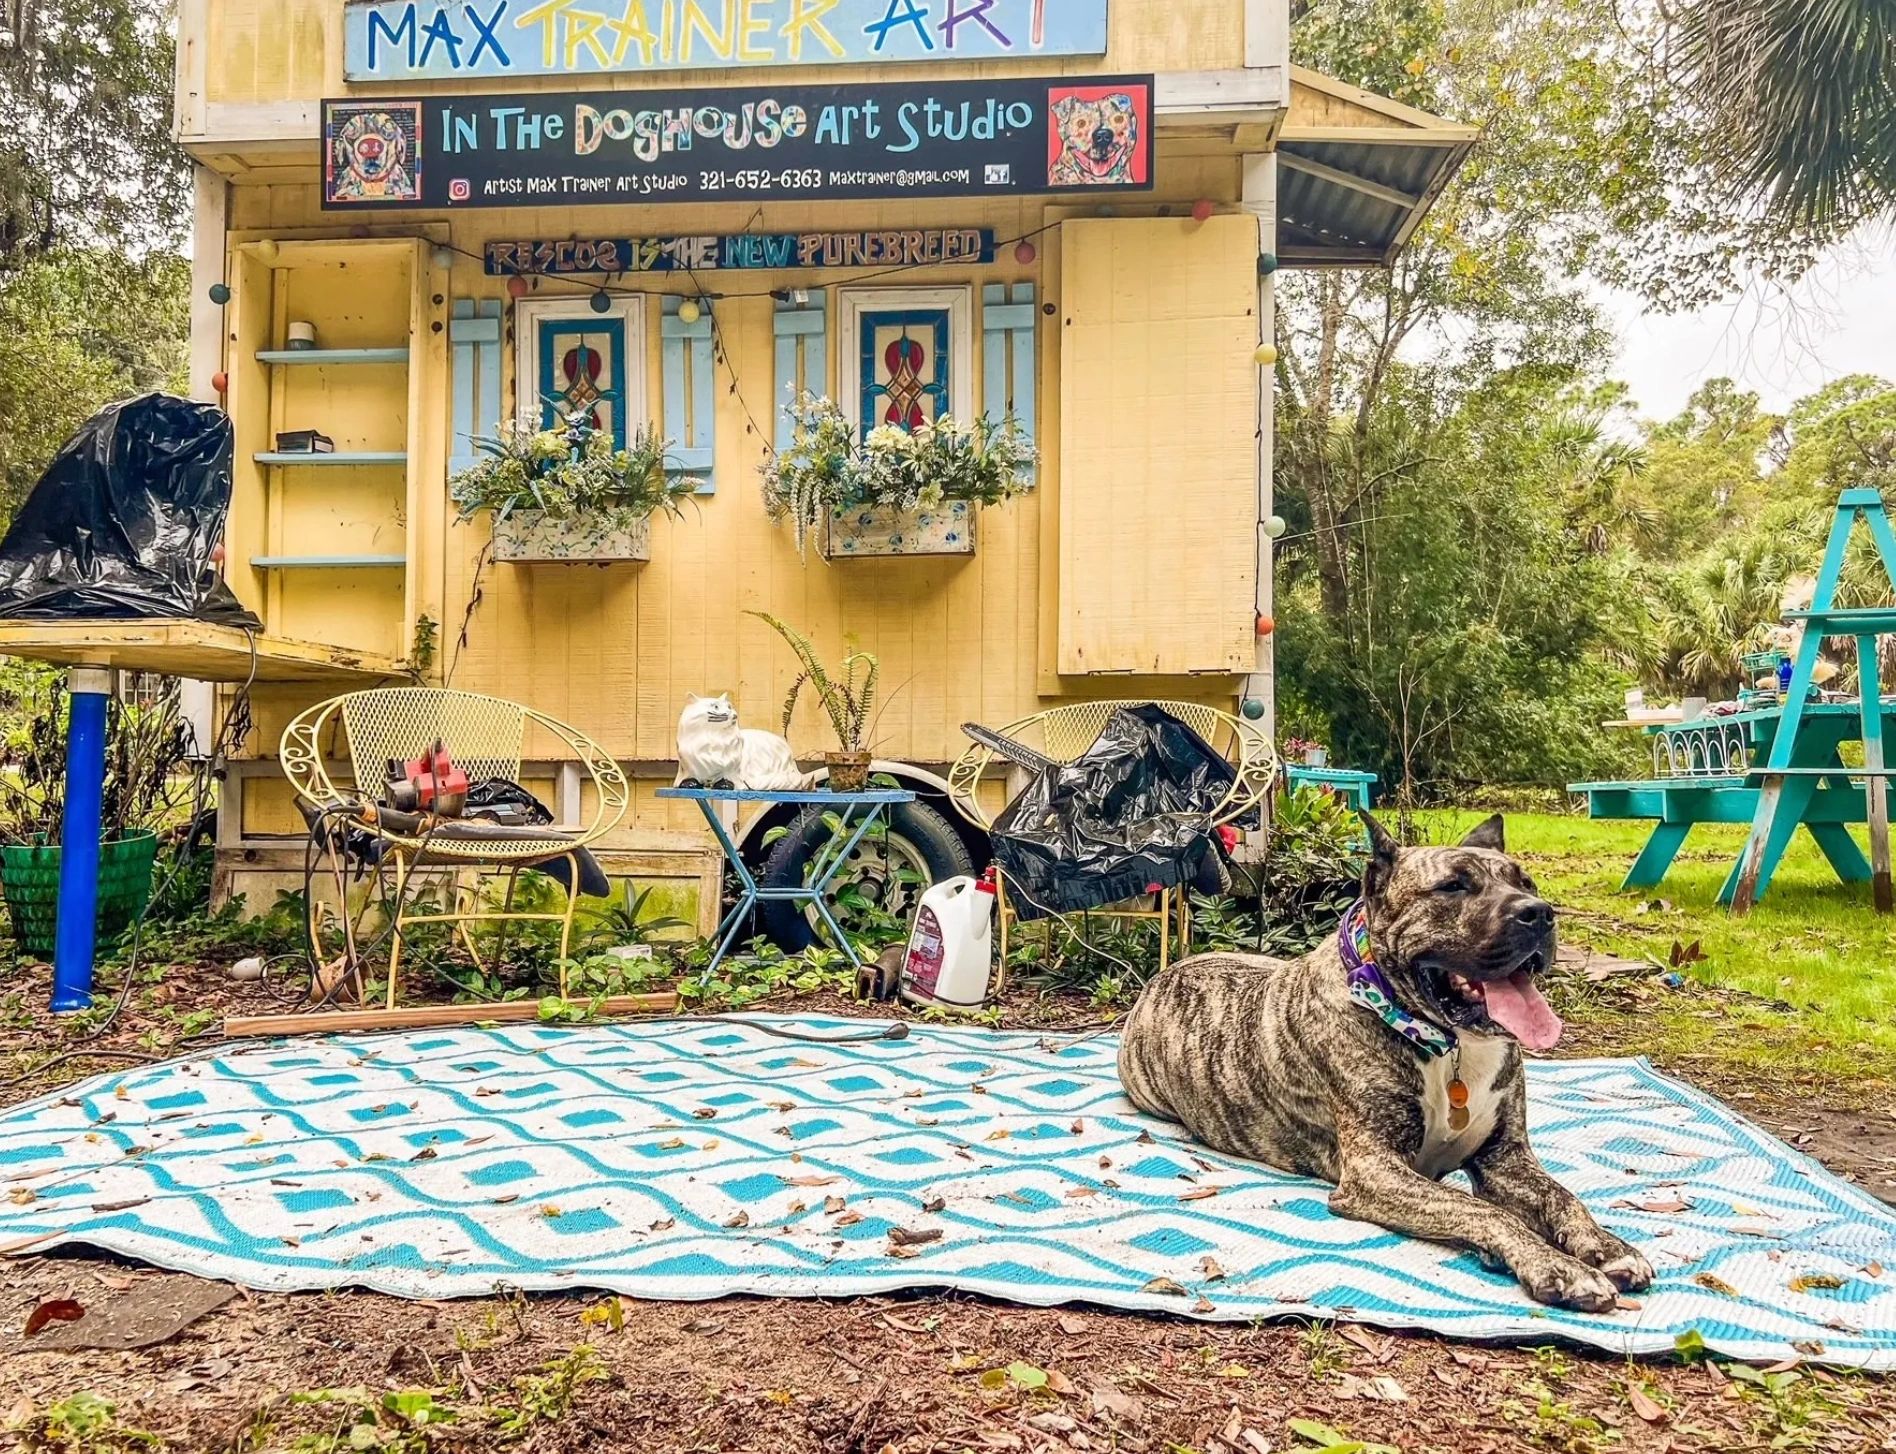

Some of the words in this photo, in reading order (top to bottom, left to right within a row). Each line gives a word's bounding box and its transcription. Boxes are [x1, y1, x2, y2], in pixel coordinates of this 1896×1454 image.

[367, 2, 511, 70] MAX
[513, 0, 847, 68] TRAINER
[814, 98, 882, 146] Art
[484, 176, 523, 195] Artist
[616, 173, 638, 192] Art
[639, 172, 689, 195] Studio
[699, 168, 823, 190] 321-652-6363
[722, 234, 797, 269] NEW
[797, 230, 982, 267] PUREBREED
